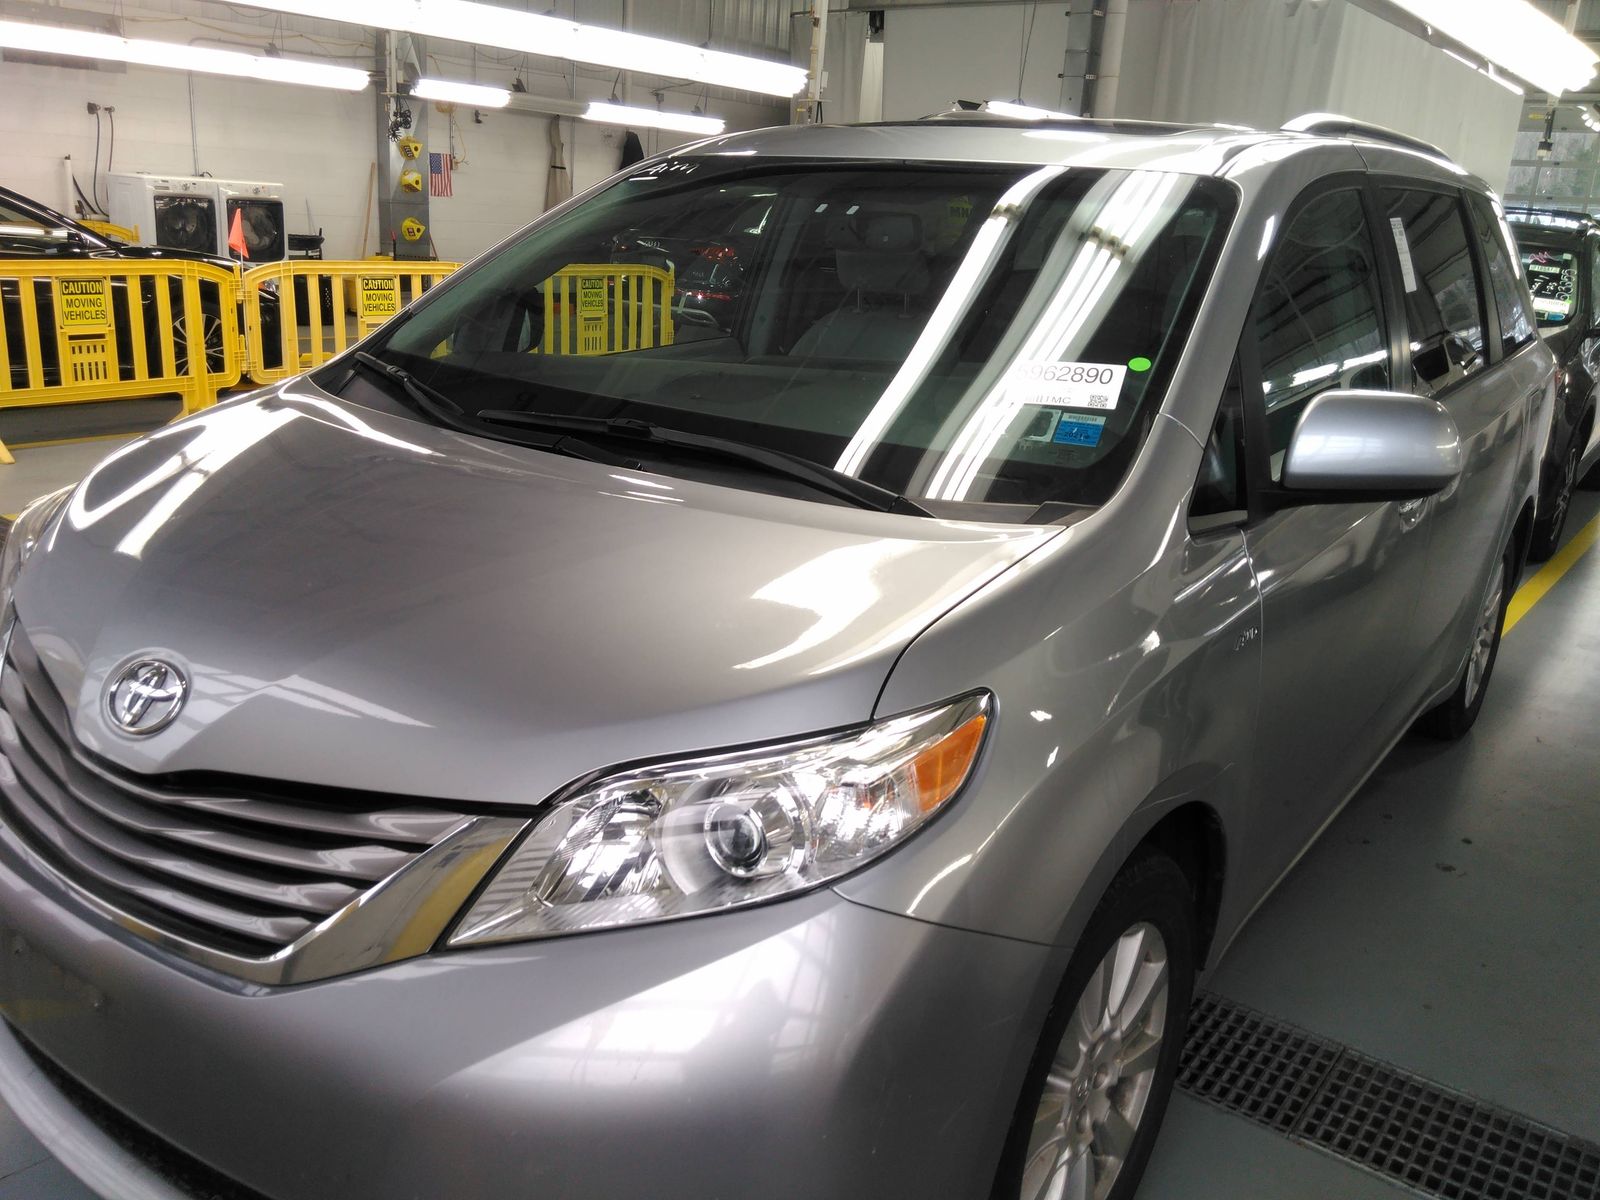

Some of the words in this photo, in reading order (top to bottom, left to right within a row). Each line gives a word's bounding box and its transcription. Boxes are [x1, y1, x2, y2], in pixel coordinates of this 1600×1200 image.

[62, 281, 103, 294] CAUTION
[363, 279, 394, 290] CAUTION
[366, 293, 393, 302] MOVING
[583, 291, 603, 299] MOVING
[66, 298, 102, 309] MOVING
[364, 303, 396, 312] VEHICLES
[582, 300, 604, 308] VEHICLES
[64, 310, 106, 321] VEHICLES
